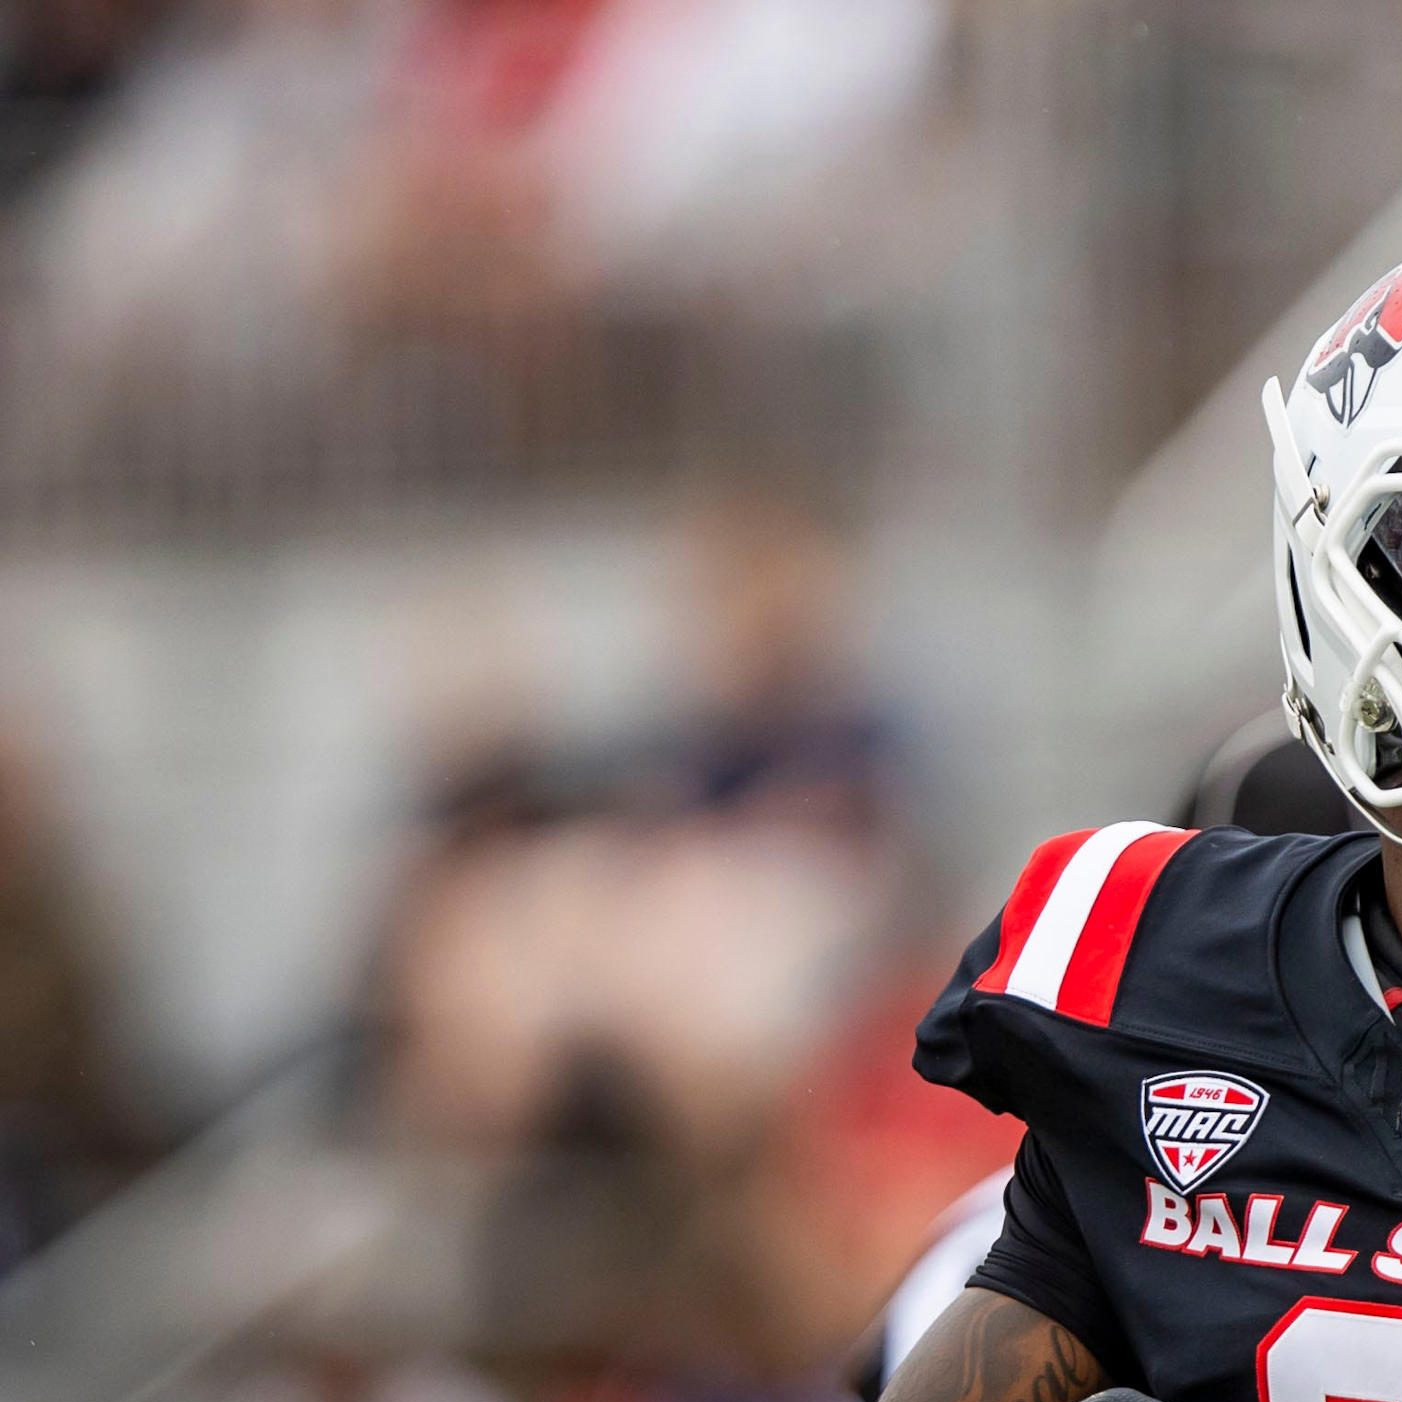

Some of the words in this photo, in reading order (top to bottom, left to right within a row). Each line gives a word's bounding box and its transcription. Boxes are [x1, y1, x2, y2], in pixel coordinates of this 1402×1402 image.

[1189, 1087, 1223, 1101] 1946
[1146, 1106, 1250, 1141] MAC
[1141, 1178, 1359, 1275] BALL
